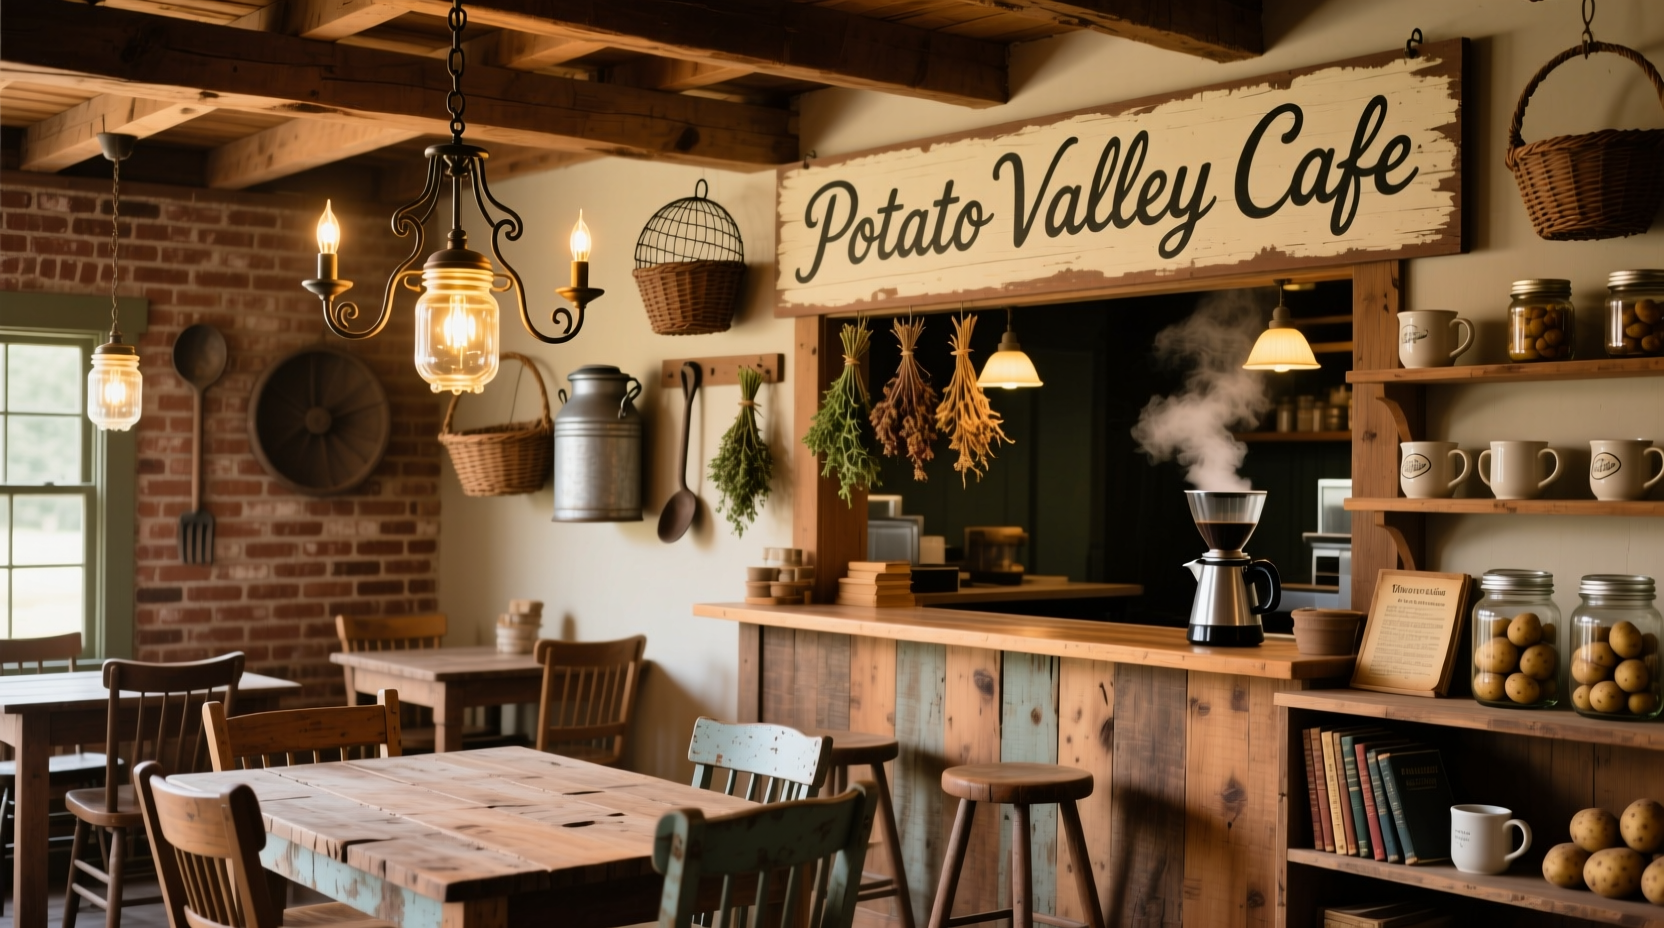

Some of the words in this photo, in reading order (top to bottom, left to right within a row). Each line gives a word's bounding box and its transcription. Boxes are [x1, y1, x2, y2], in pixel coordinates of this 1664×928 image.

[795, 180, 994, 284] Potato
[993, 131, 1216, 258] Valley
[1234, 95, 1419, 236] Cafe
